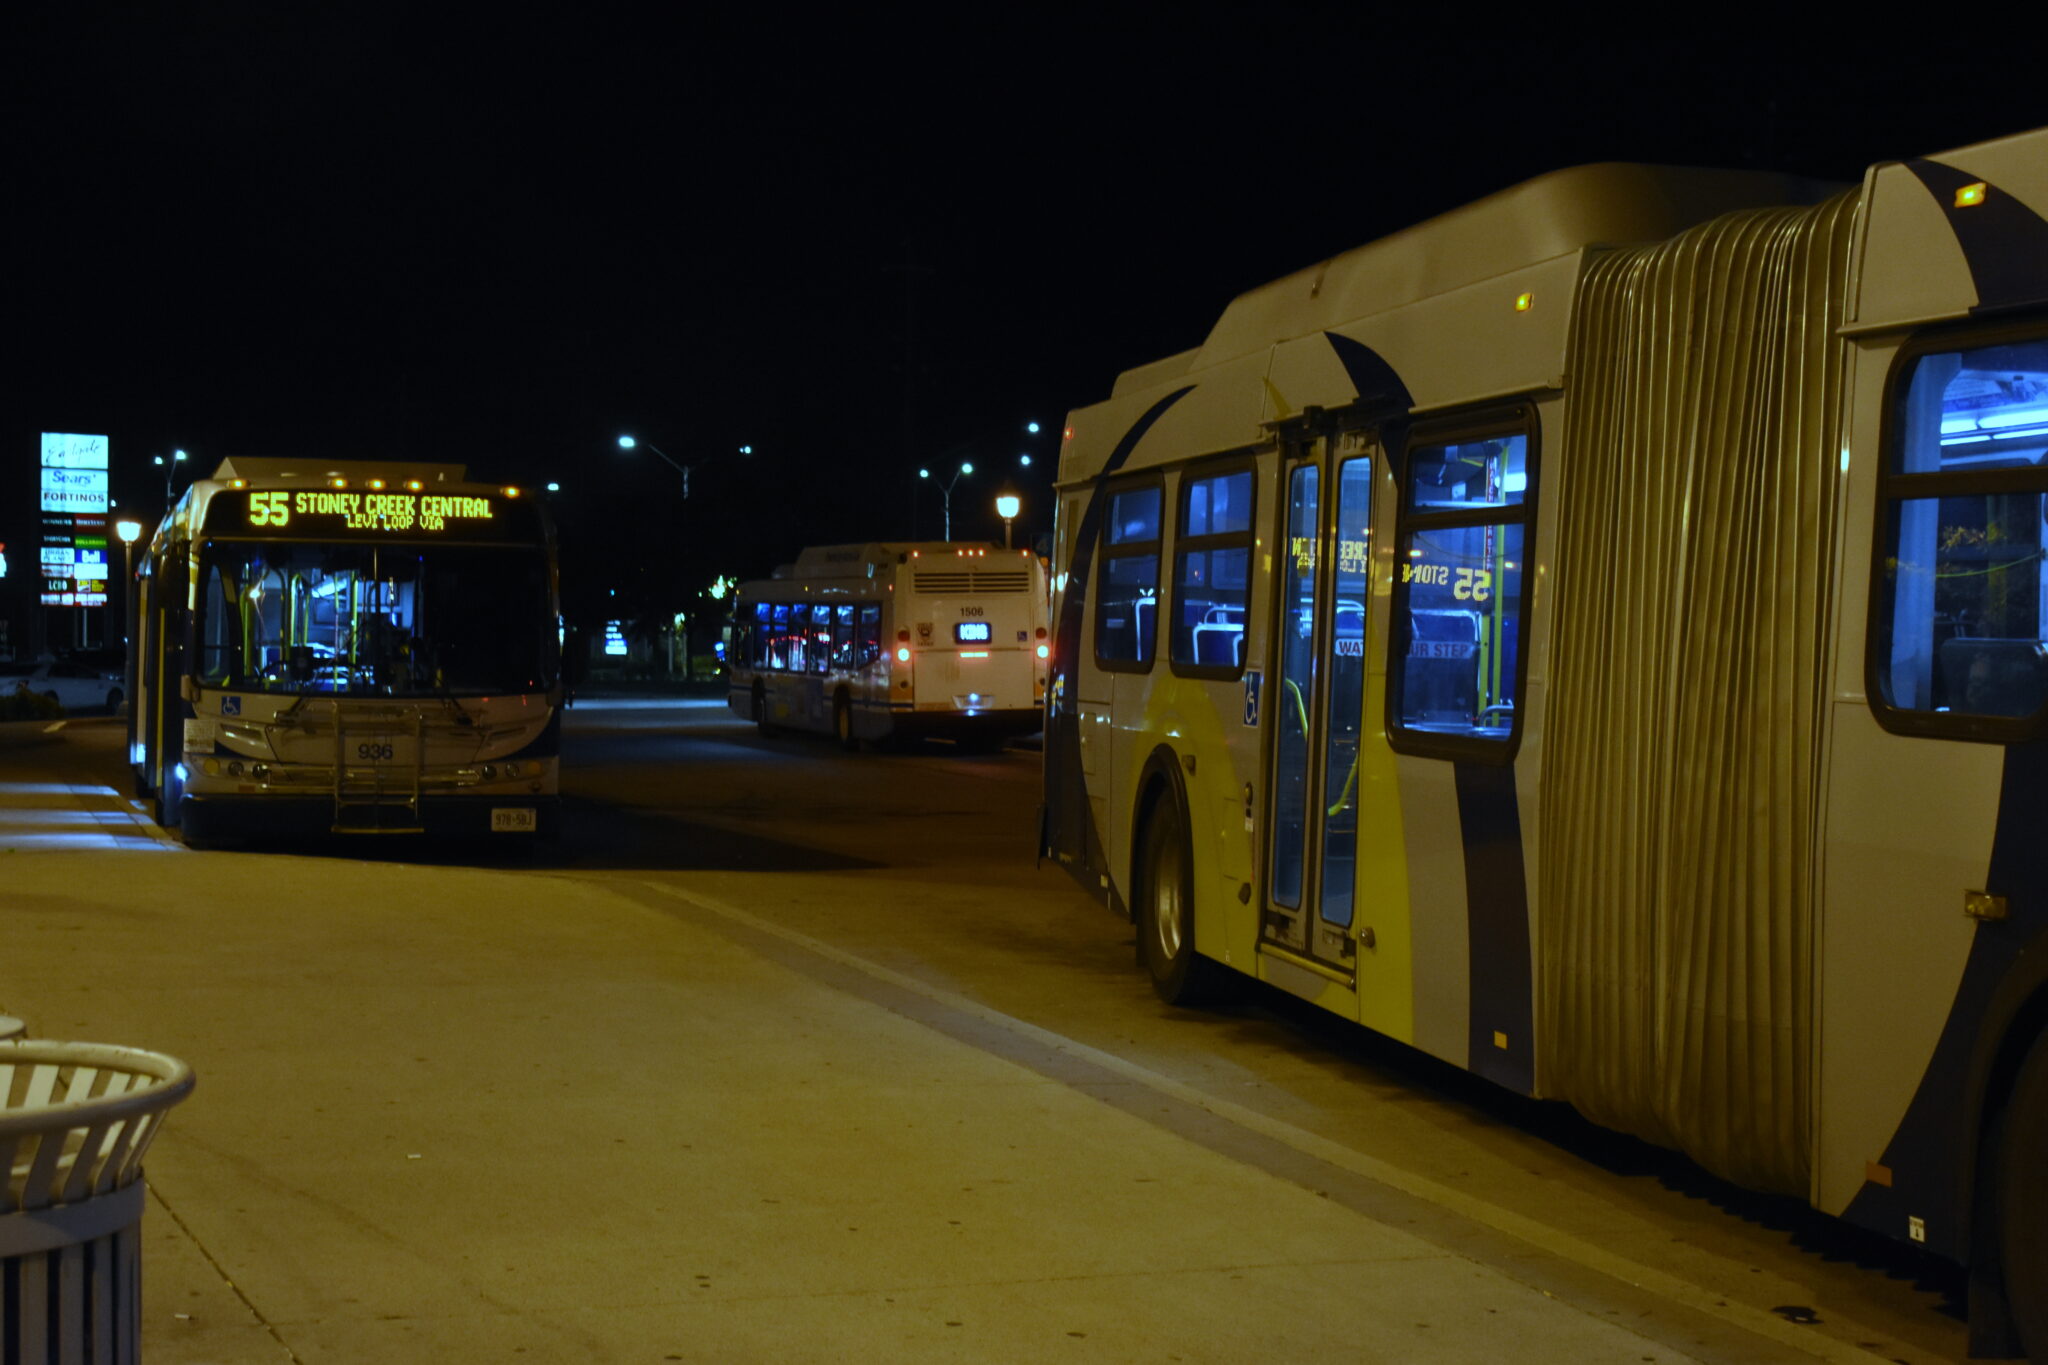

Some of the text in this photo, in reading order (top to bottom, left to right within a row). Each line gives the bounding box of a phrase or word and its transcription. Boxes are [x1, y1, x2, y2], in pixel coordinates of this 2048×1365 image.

[52, 470, 91, 485] Sears
[43, 492, 105, 503] FORTINOS
[249, 491, 493, 526] 55 STONEY CREEK CENTRAL
[346, 514, 444, 531] LEVI LOOP VIA
[960, 608, 984, 617] 1506
[1339, 641, 1364, 654] WA
[1434, 643, 1468, 657] STEP
[358, 743, 393, 760] 936
